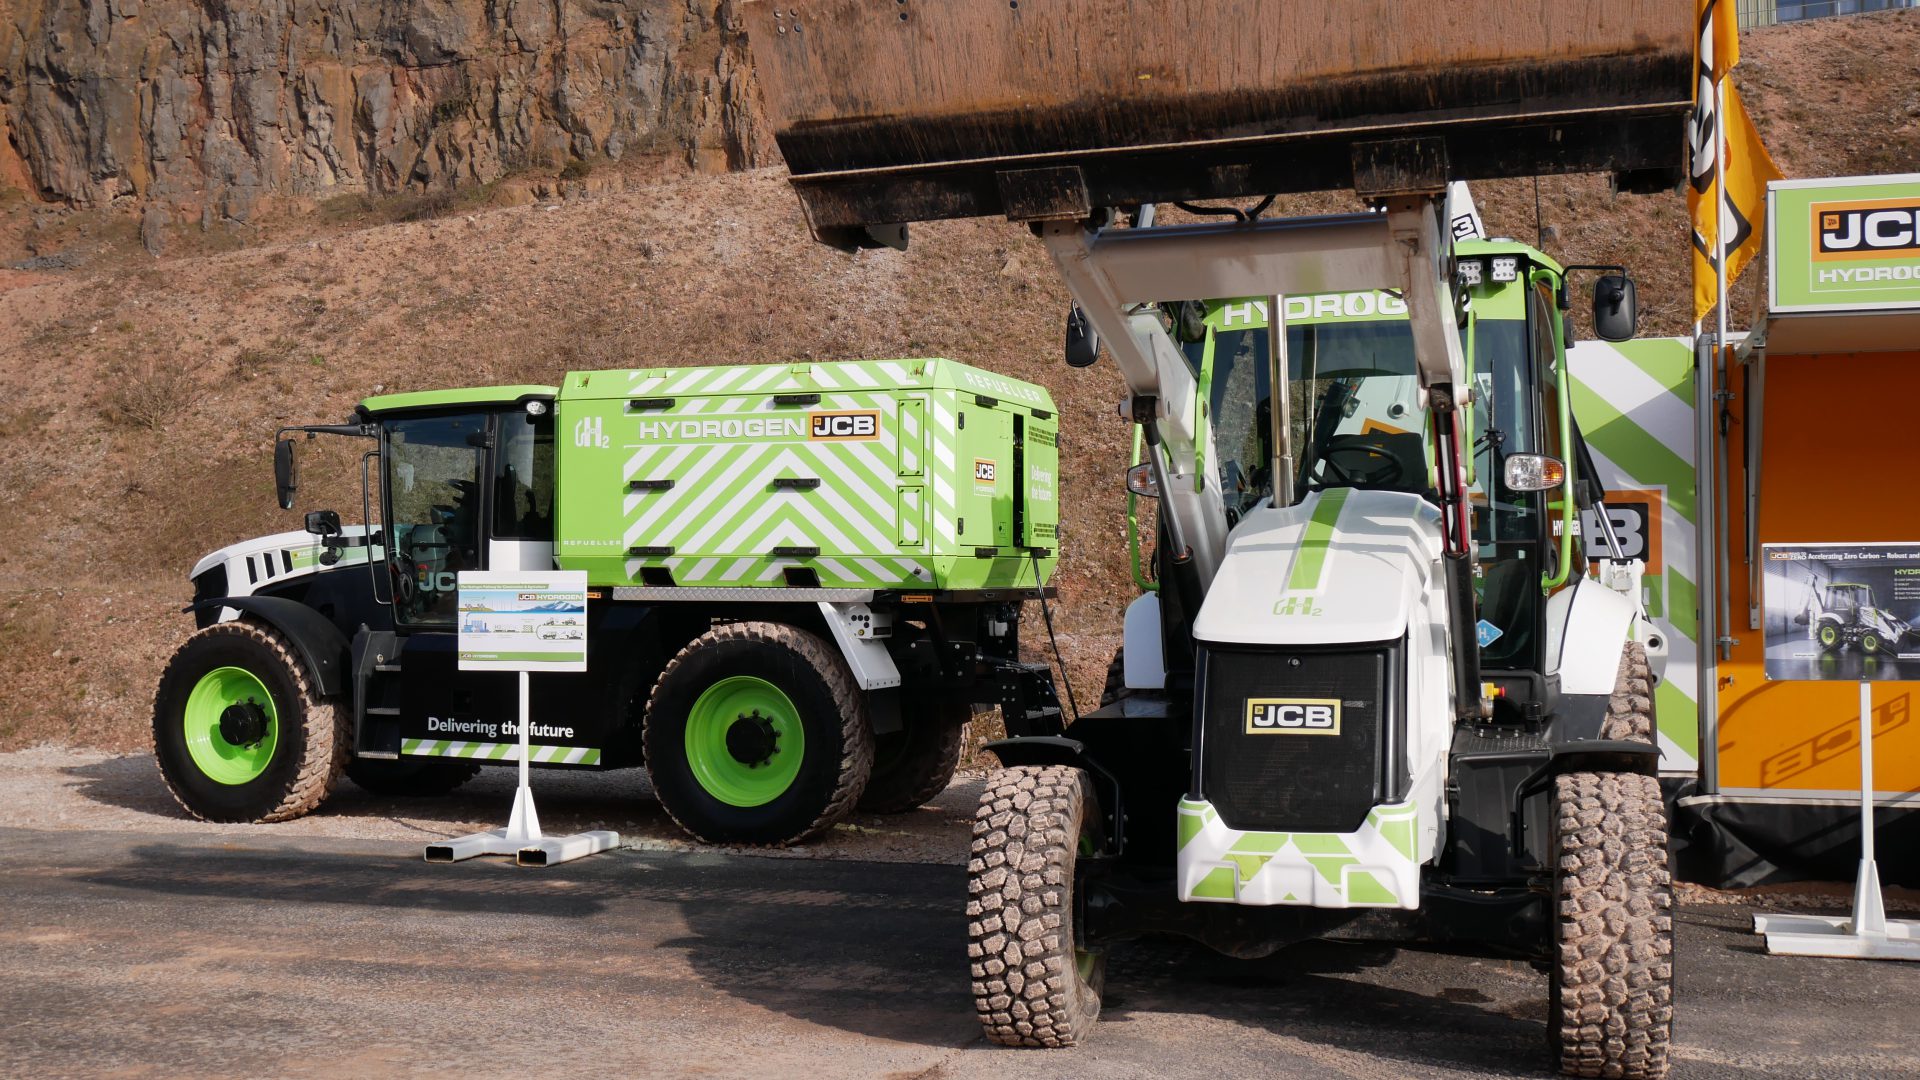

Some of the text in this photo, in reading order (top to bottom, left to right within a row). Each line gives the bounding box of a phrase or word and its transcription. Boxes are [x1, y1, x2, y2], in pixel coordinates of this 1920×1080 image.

[1824, 210, 1920, 249] JC
[1223, 291, 1409, 326] HYDROG
[964, 372, 1042, 403] REFUELLER
[639, 416, 875, 439] HYDROGEN JCB
[976, 463, 994, 480] JCB
[1031, 464, 1052, 488] Delivering
[1038, 485, 1052, 501] future
[419, 572, 456, 591] JC
[1254, 705, 1333, 727] JCB
[427, 717, 497, 738] Delivering
[529, 721, 574, 738] future
